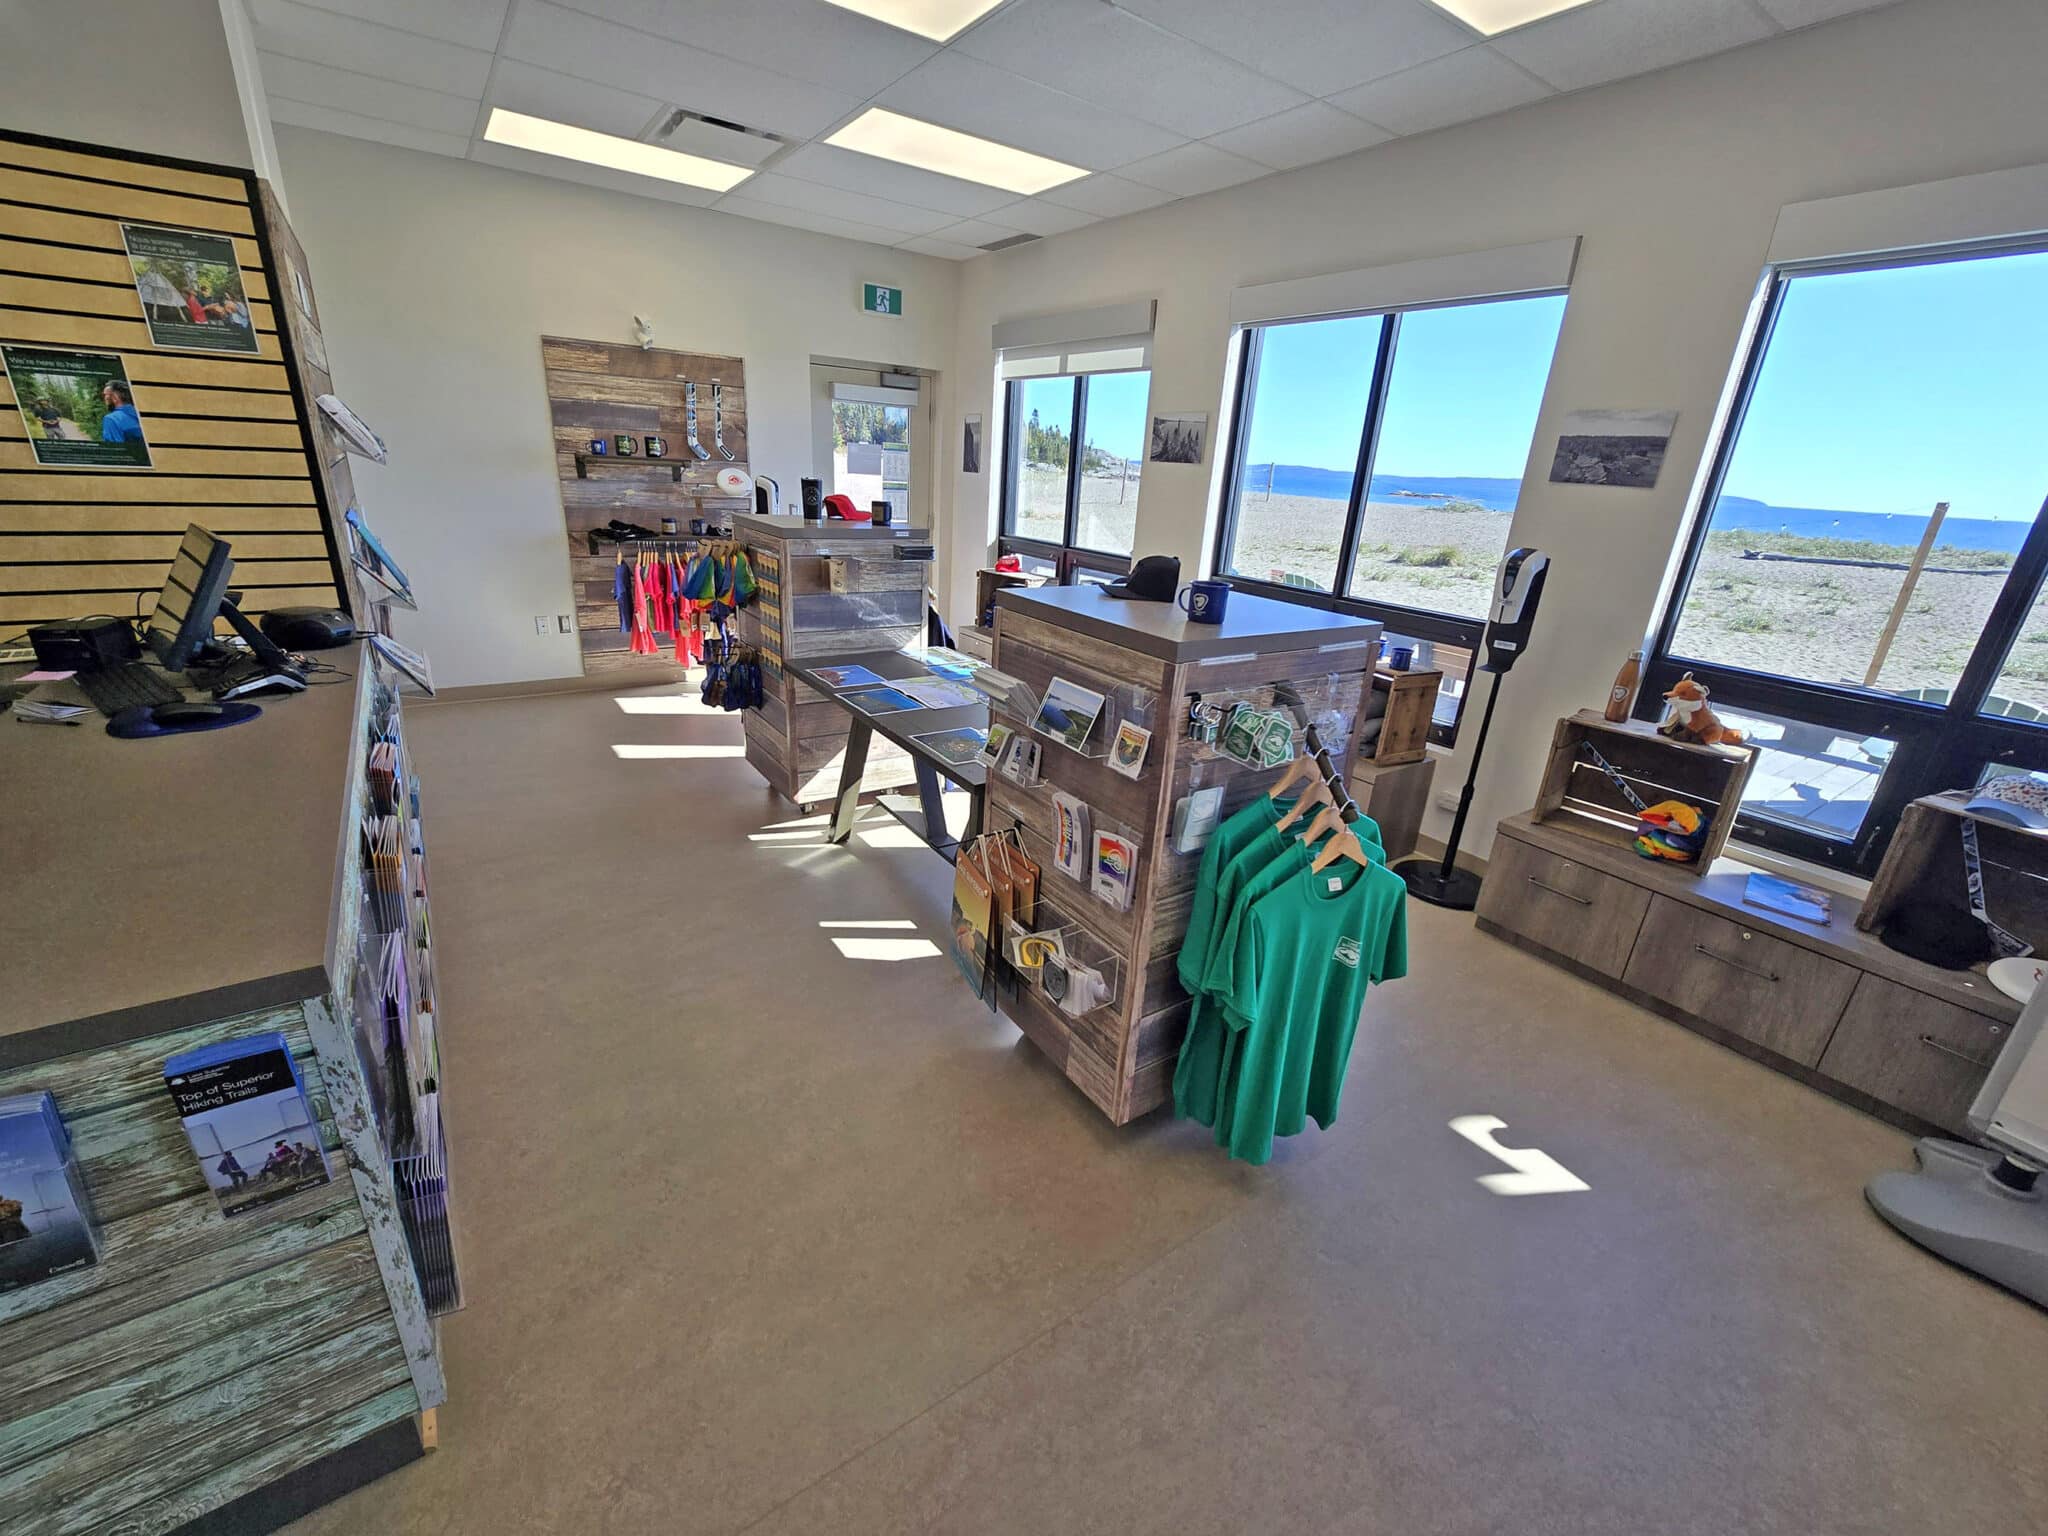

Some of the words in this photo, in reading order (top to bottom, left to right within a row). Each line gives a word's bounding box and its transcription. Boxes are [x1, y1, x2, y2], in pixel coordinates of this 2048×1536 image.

[178, 1091, 203, 1103] Top
[206, 1085, 219, 1095] of
[222, 1071, 275, 1091] Superior
[181, 1096, 224, 1112] Hiking
[226, 1086, 259, 1100] Trails
